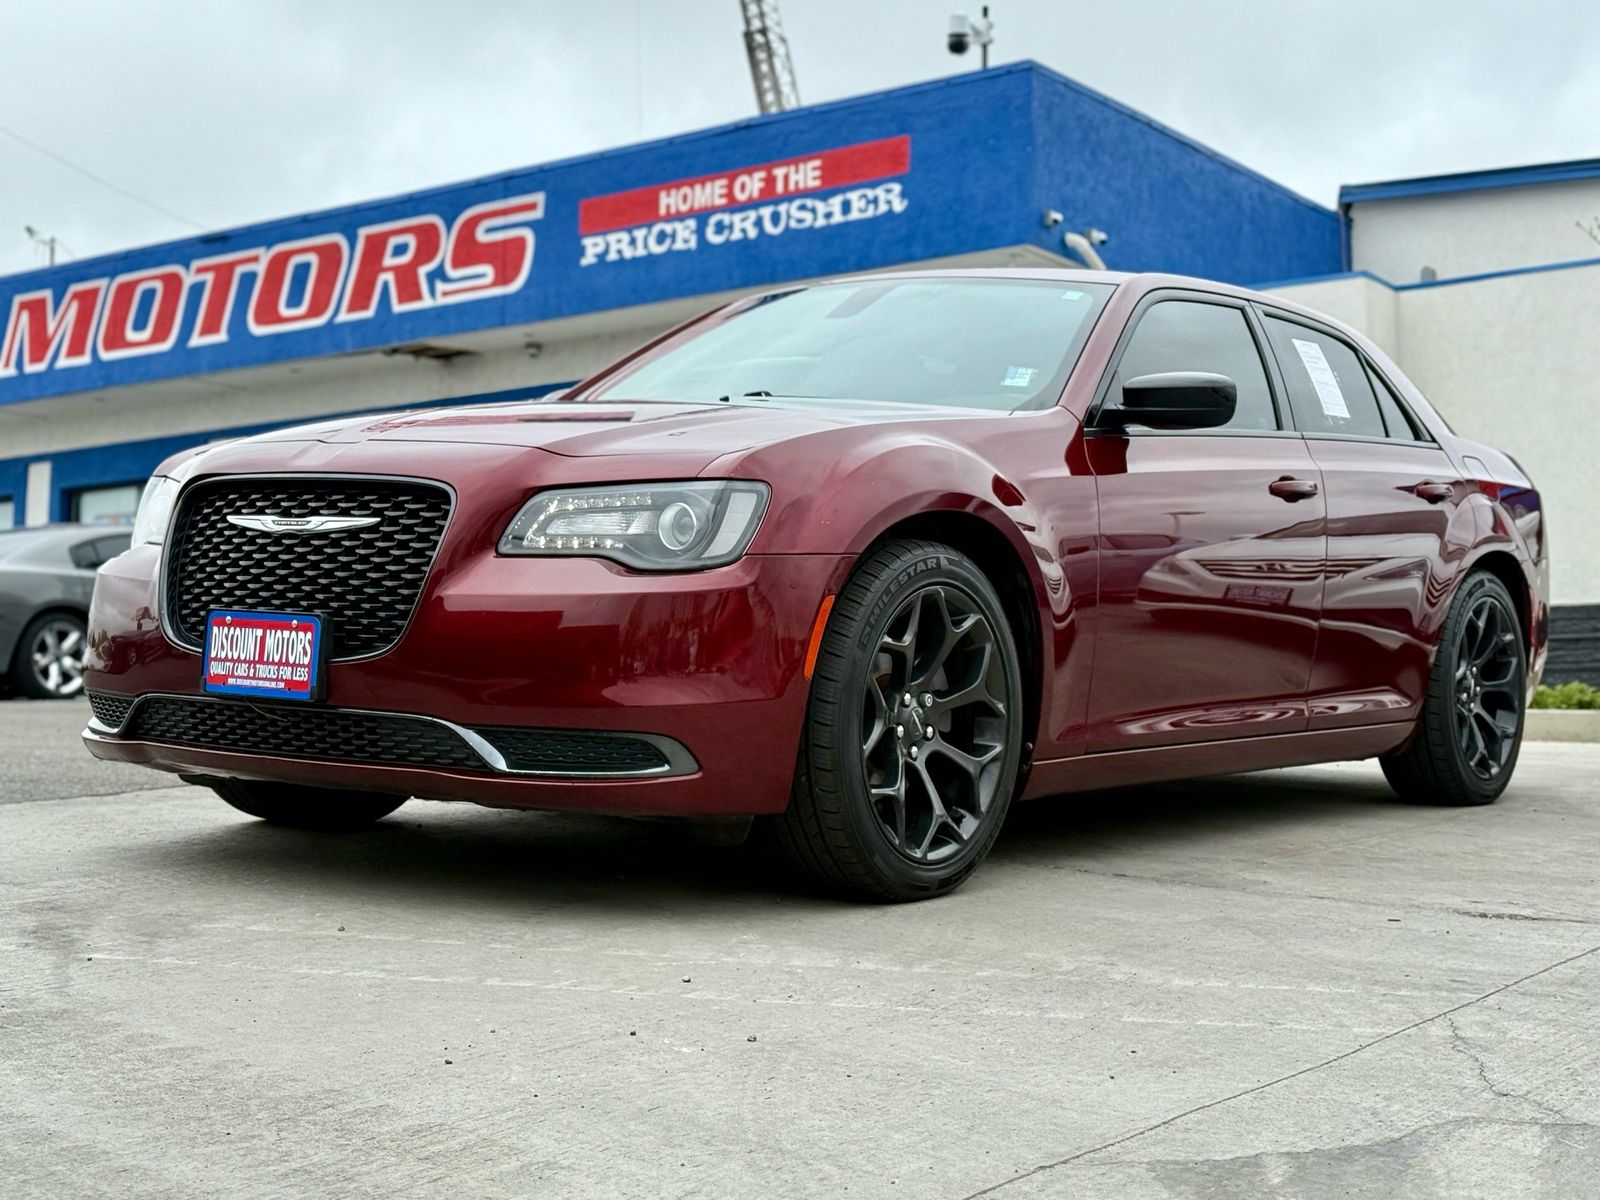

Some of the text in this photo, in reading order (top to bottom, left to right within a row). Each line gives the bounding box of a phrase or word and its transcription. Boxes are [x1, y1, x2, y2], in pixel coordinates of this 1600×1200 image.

[659, 160, 822, 216] HOME OF THE
[580, 182, 908, 266] PRICE CRUSHER
[0, 192, 546, 378] MOTORS
[868, 558, 937, 626] MILESTAR
[210, 626, 312, 665] DISCOUNT MOTORS
[210, 661, 309, 682] QUALITY CARS & TRUCKS FOR LESS
